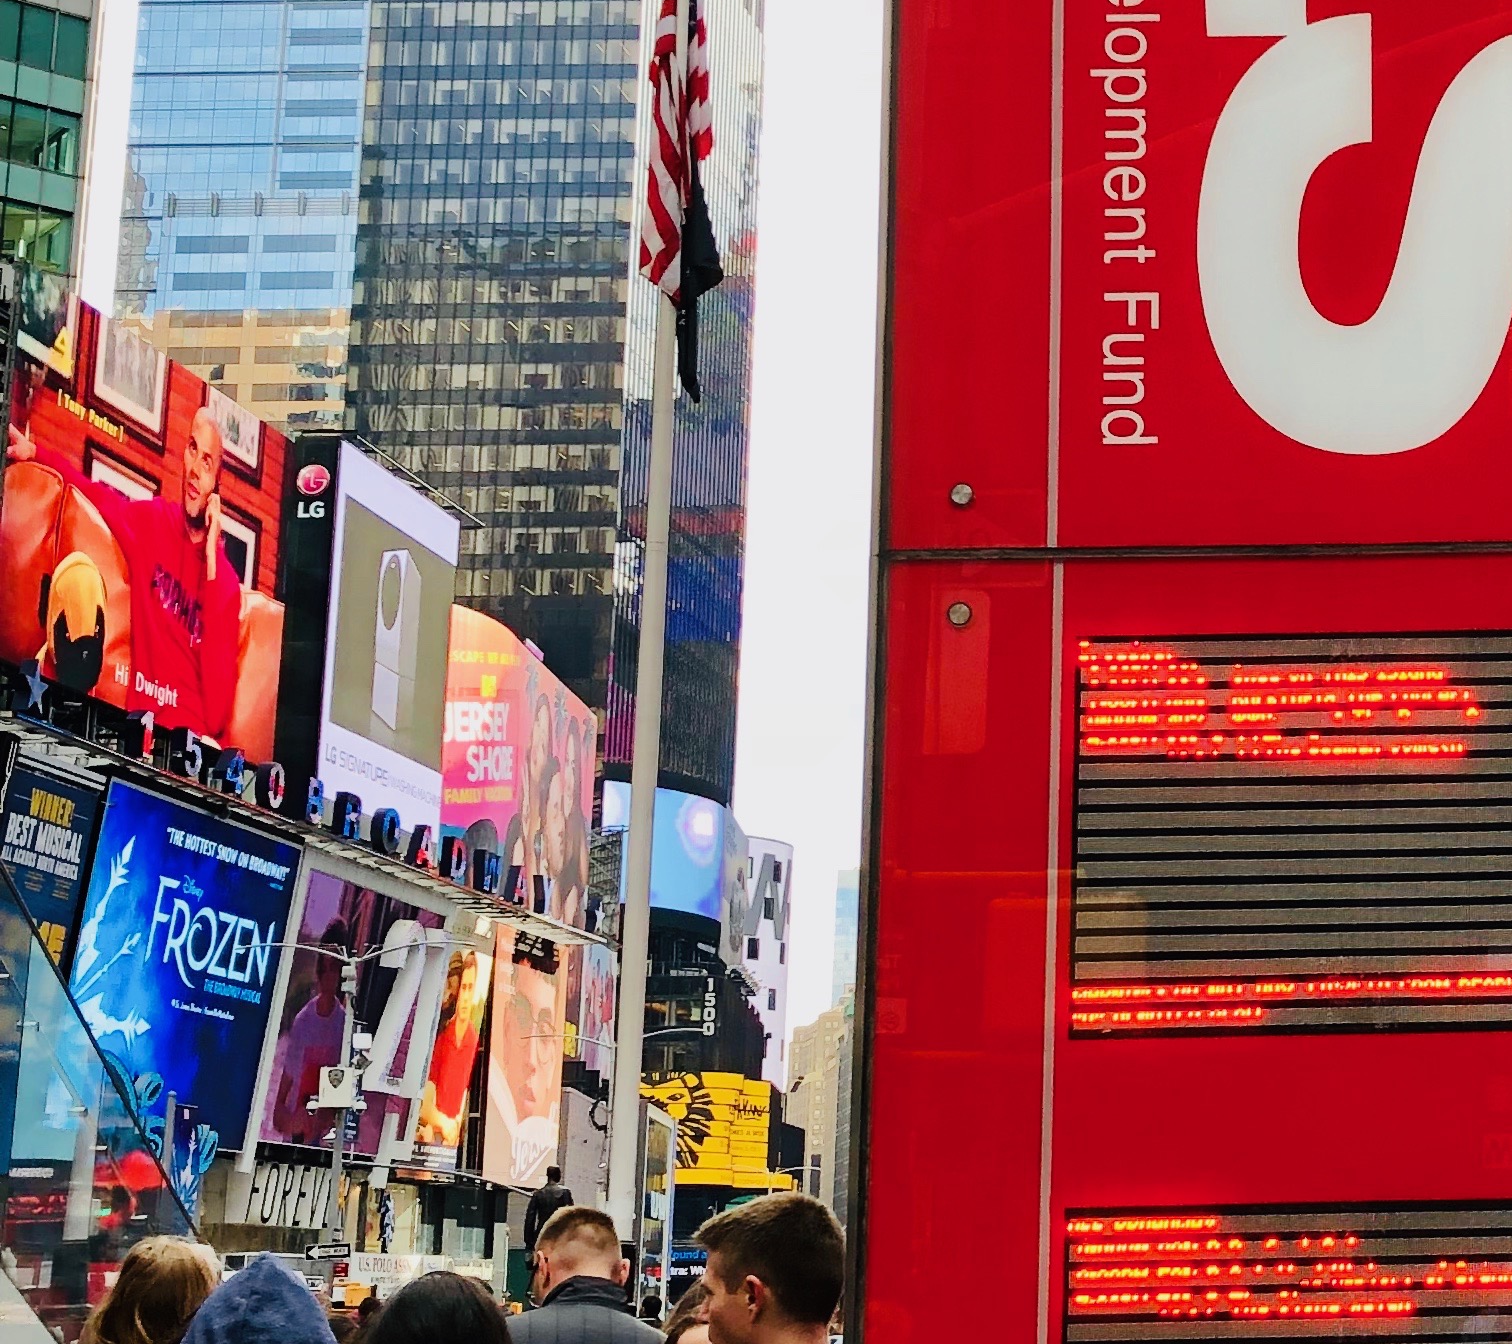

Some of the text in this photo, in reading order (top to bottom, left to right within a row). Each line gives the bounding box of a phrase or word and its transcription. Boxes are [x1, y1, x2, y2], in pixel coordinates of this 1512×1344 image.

[1100, 291, 1160, 446] Fund
[297, 501, 326, 519] LG
[115, 662, 179, 708] Hi Dwight
[444, 701, 510, 743] JERSEY
[4, 811, 84, 865] BEST MUSICAL
[184, 832, 217, 858] HOTTEST
[144, 874, 277, 989] FROZEN
[702, 976, 717, 1037] 1500
